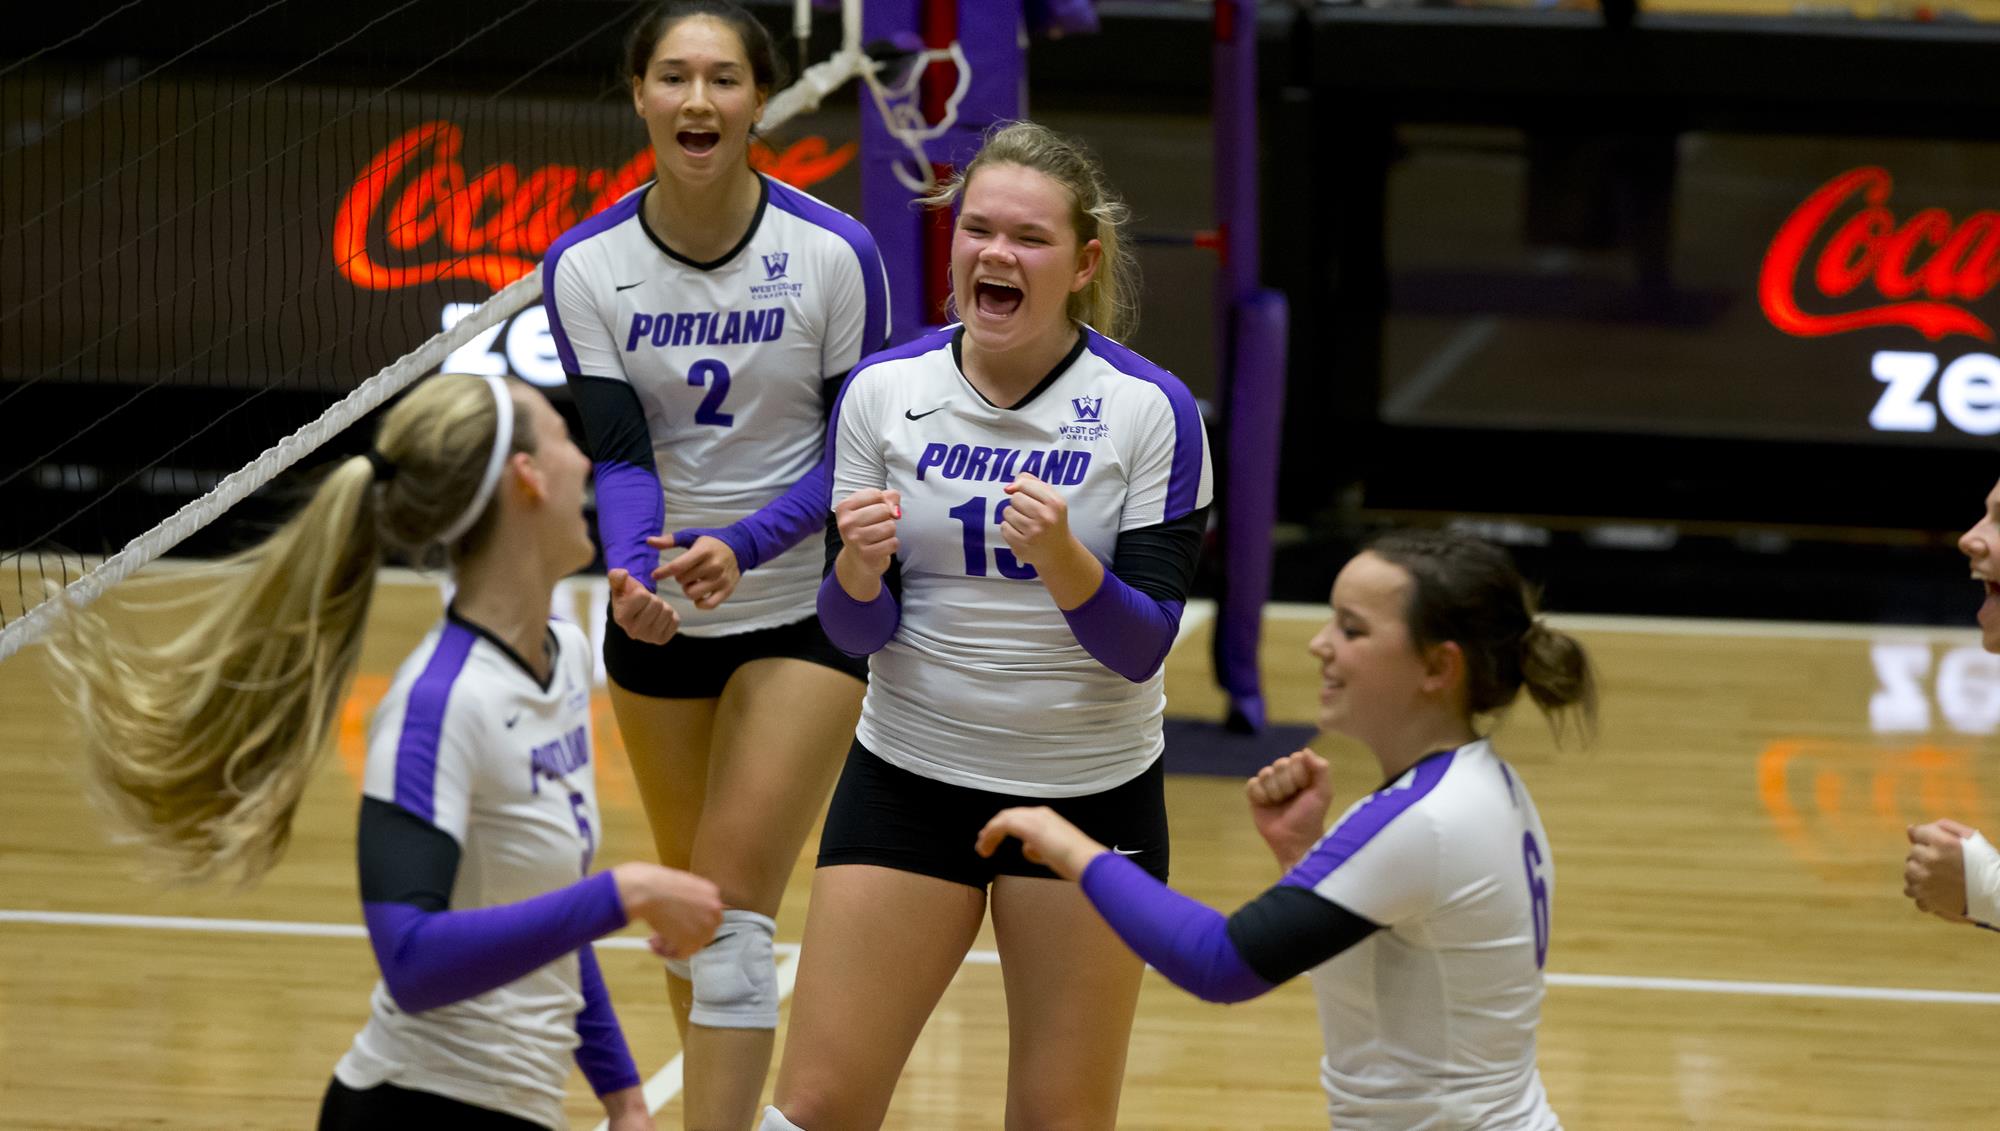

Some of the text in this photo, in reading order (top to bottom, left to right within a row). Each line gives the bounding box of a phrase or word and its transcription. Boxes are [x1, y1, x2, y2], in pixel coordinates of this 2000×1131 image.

[749, 282, 802, 294] WEST COST
[626, 307, 785, 352] PORTLAND
[687, 358, 734, 428] 2
[1059, 425, 1087, 435] WEST
[916, 442, 1092, 486] PORTLAND
[1522, 829, 1549, 970] 6
